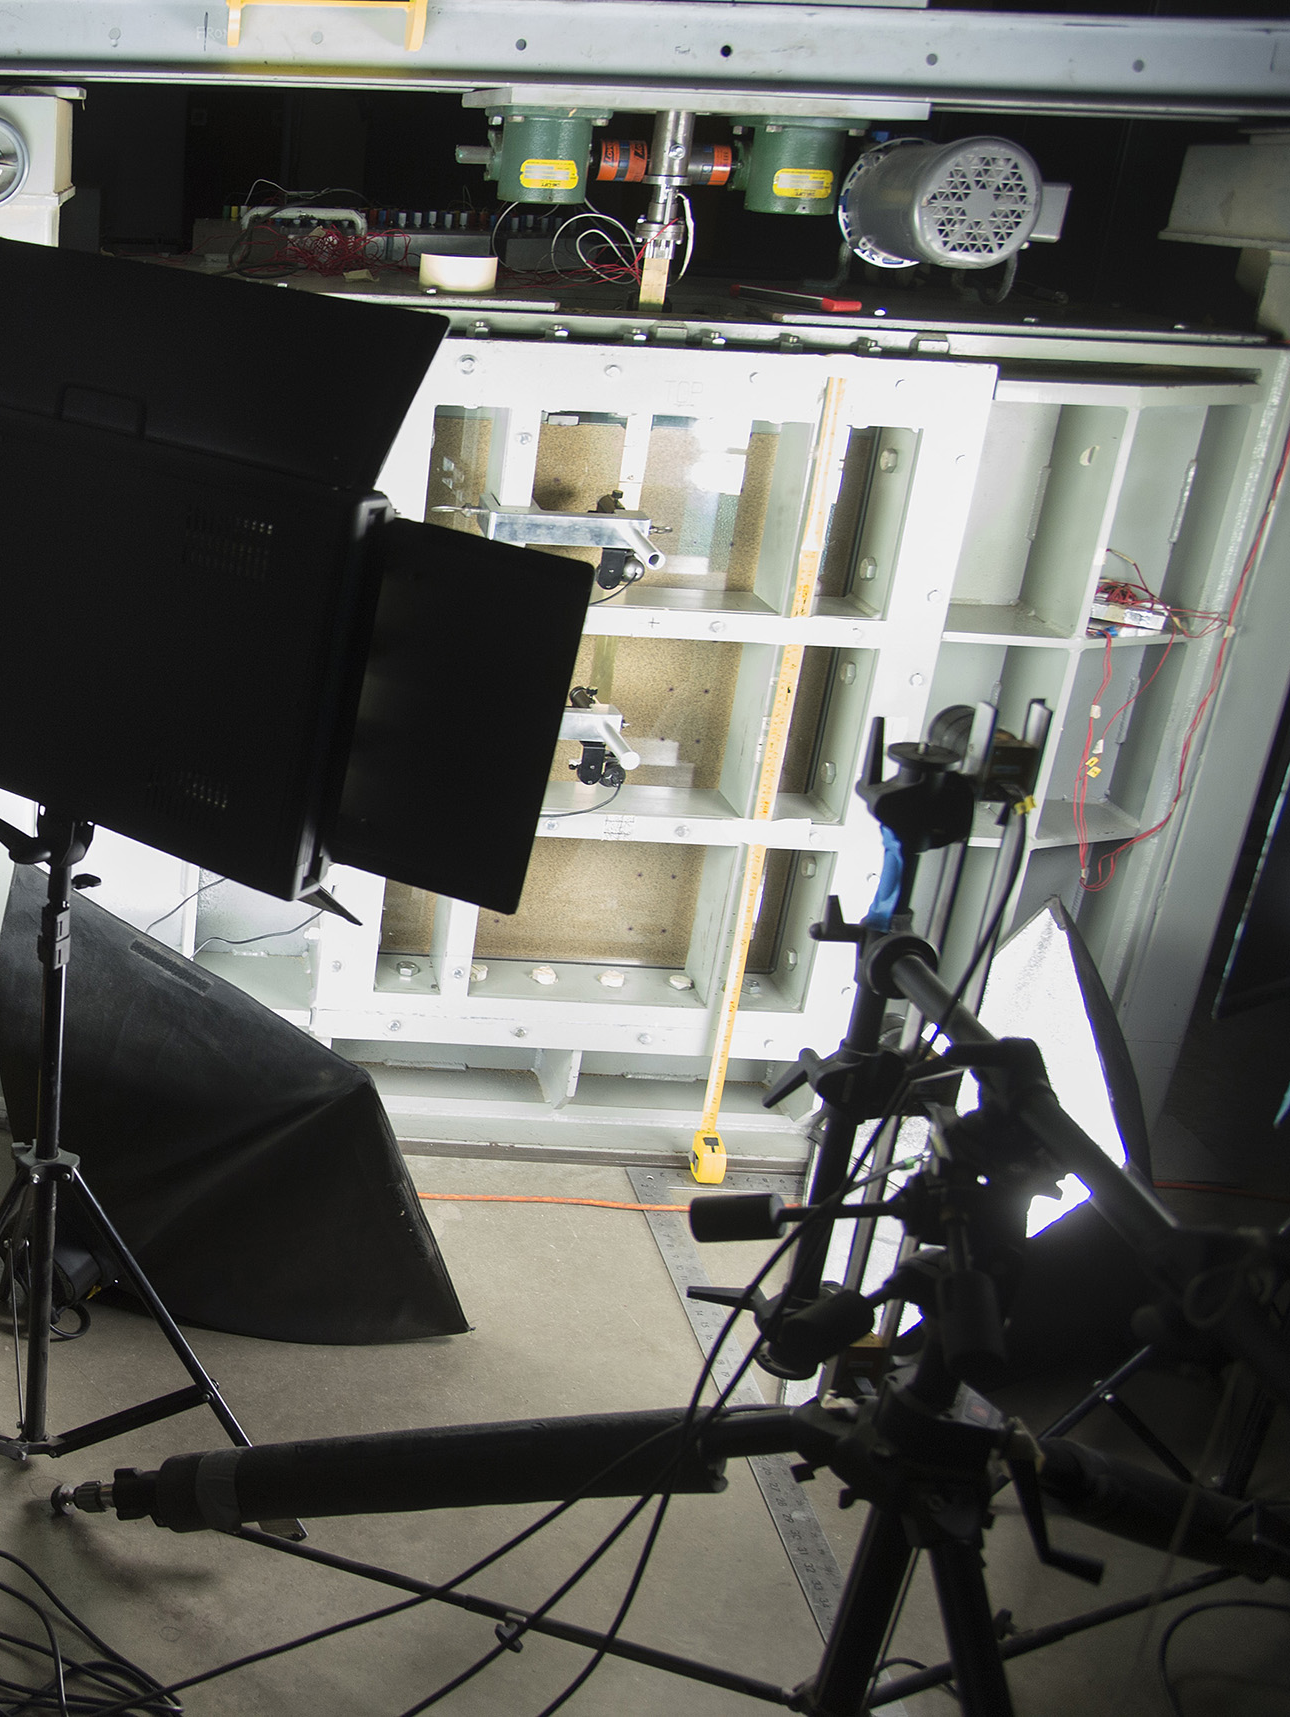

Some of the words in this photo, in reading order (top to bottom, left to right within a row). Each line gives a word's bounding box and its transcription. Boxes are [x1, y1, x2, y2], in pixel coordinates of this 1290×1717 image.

[770, 1482, 781, 1493] 27
[776, 1497, 788, 1508] 28
[782, 1513, 795, 1524] 29
[797, 1546, 809, 1556] 31
[804, 1561, 816, 1574] 32
[811, 1579, 824, 1592] 33
